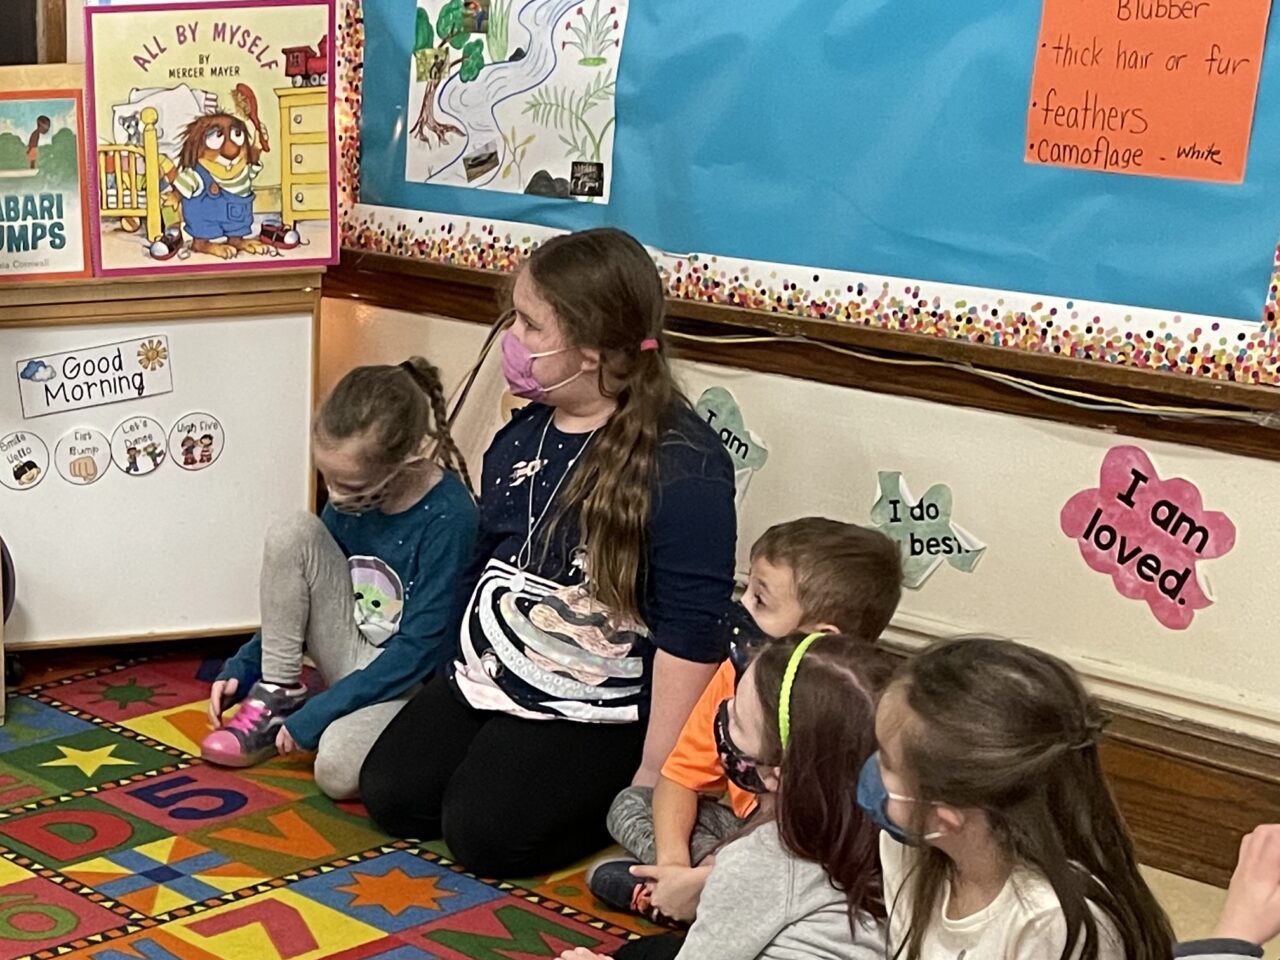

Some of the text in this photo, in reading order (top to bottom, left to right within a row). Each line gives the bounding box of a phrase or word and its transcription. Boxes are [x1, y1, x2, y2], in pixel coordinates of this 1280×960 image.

[1117, 0, 1210, 21] Blubber
[132, 21, 279, 73] ALL BY MYSELF
[198, 54, 211, 66] BY
[1052, 33, 1251, 76] thick hair or fur
[168, 65, 241, 79] MERCER MAYER
[1040, 87, 1149, 135] feathers
[1037, 135, 1144, 170] camoflage
[1176, 142, 1223, 165] white
[62, 347, 124, 380] Good
[44, 370, 146, 408] Morning
[719, 427, 749, 460] am
[889, 497, 940, 523] I do
[1116, 468, 1209, 554] I am
[1082, 507, 1192, 606] loved.
[124, 775, 250, 821] 5
[183, 897, 320, 960] 7
